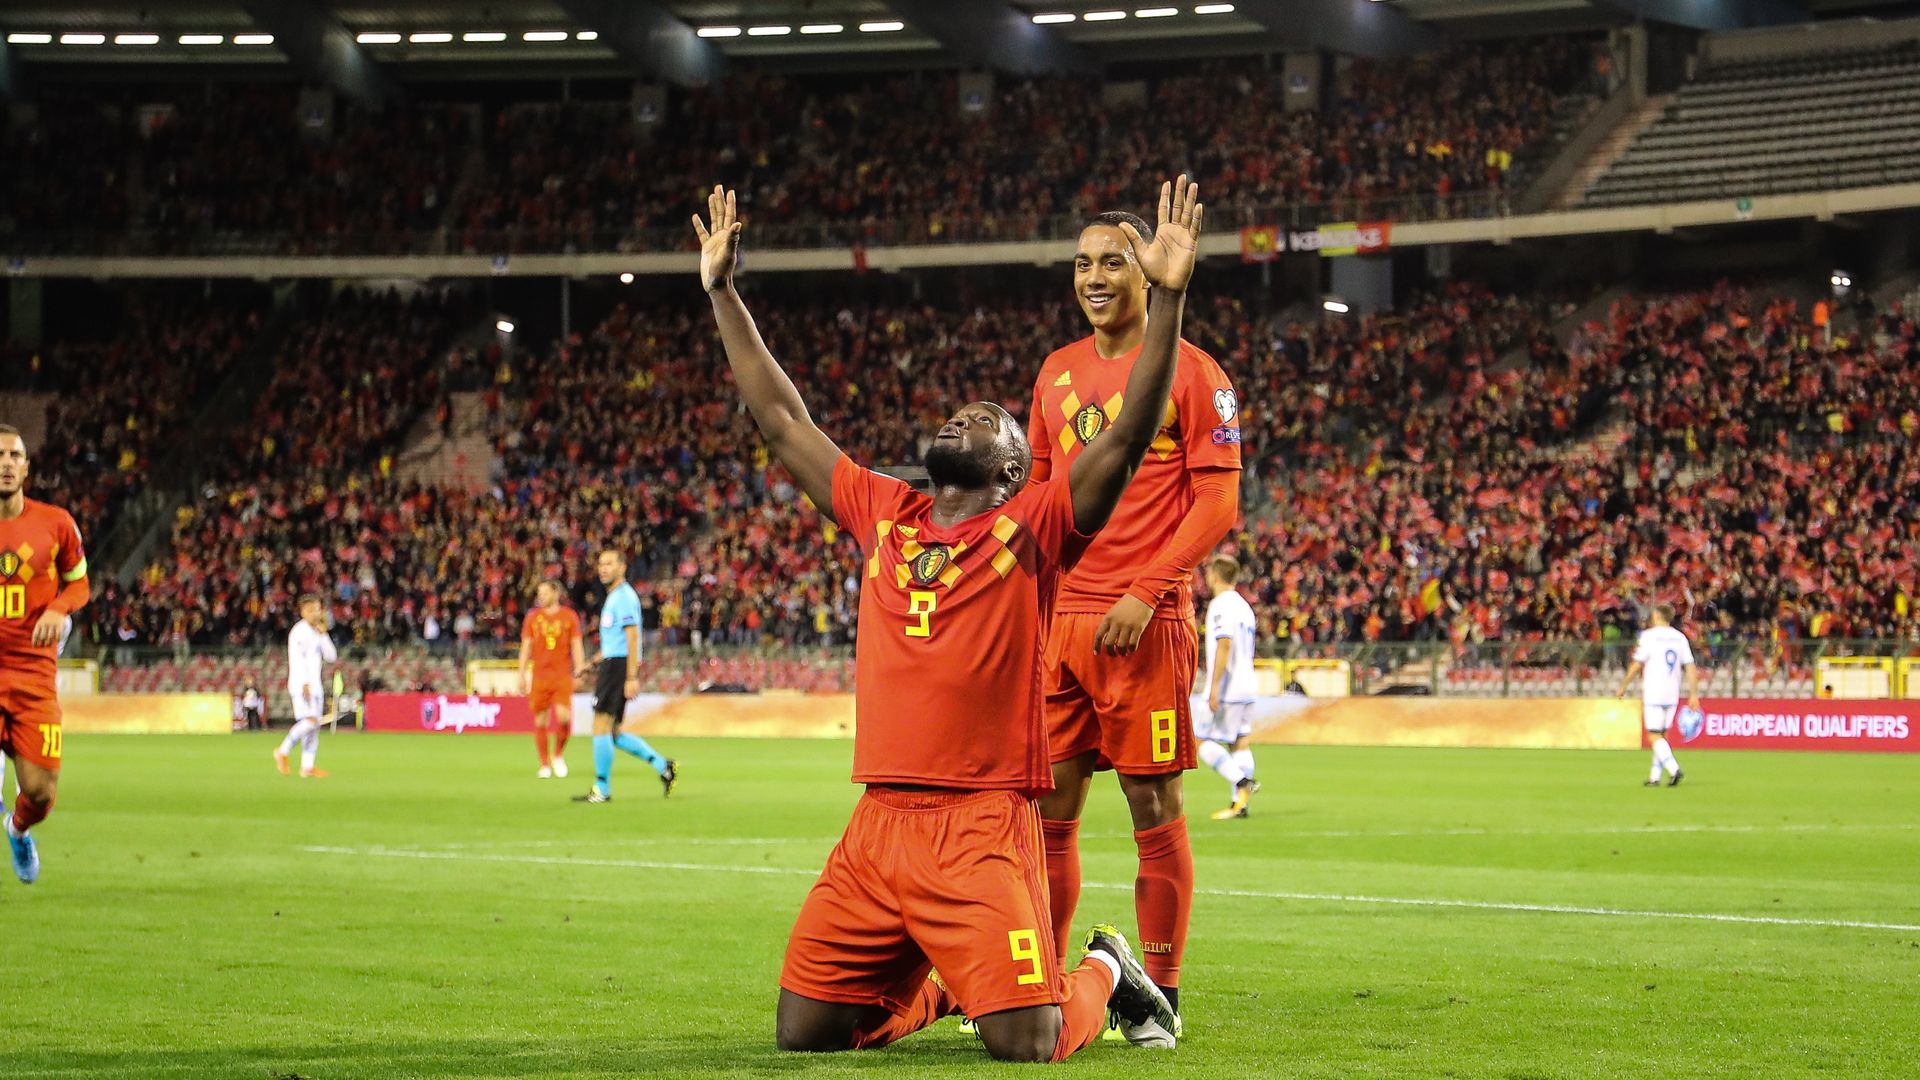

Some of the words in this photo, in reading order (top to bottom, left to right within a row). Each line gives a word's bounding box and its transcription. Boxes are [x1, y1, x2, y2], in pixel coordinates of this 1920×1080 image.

[905, 591, 937, 637] 9
[1665, 649, 1678, 673] 9
[39, 723, 62, 758] 10
[1150, 709, 1176, 763] 8
[1706, 714, 1800, 737] EUROPEAN
[1804, 715, 1909, 739] QUALIFIERS
[1008, 929, 1043, 985] 9
